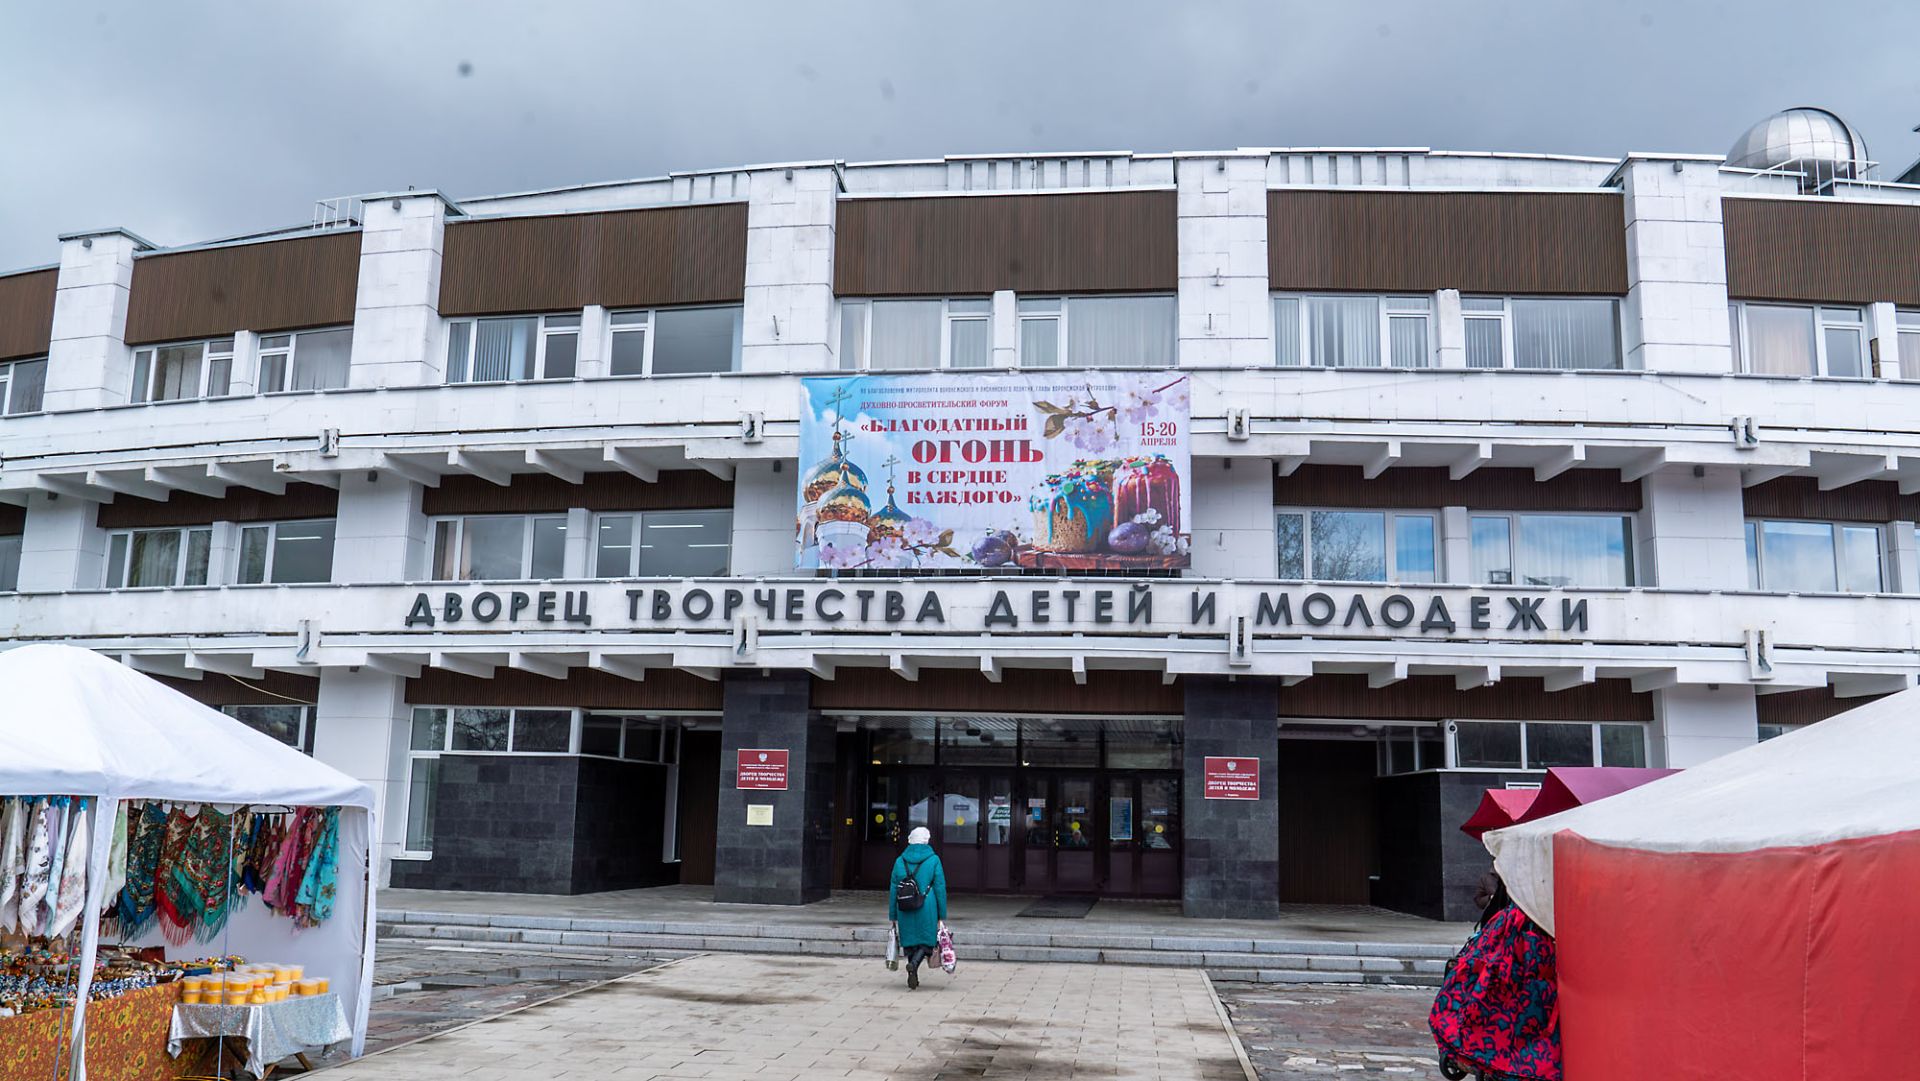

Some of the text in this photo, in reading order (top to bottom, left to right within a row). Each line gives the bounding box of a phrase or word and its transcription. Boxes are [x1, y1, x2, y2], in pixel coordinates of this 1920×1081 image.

[860, 400, 1009, 410] ДУХОВНО-ПРОСВЕТИТЕЛЬСКИЙ ФОРУМ
[860, 414, 1028, 434] «БЛАГОДАТНЫЙ
[1140, 421, 1177, 436] 15-20
[1140, 438, 1177, 446] АПРЕЛЯ
[911, 439, 1044, 463] ОГОНЬ
[907, 470, 1007, 486] В СЕРДЦЕ
[907, 490, 1022, 506] КАЖДОГО»
[405, 584, 1589, 633] ДВОРЕЦ ТВОРЧЕСТВА ДЕТЕЙ И МОЛОДЕЖИ
